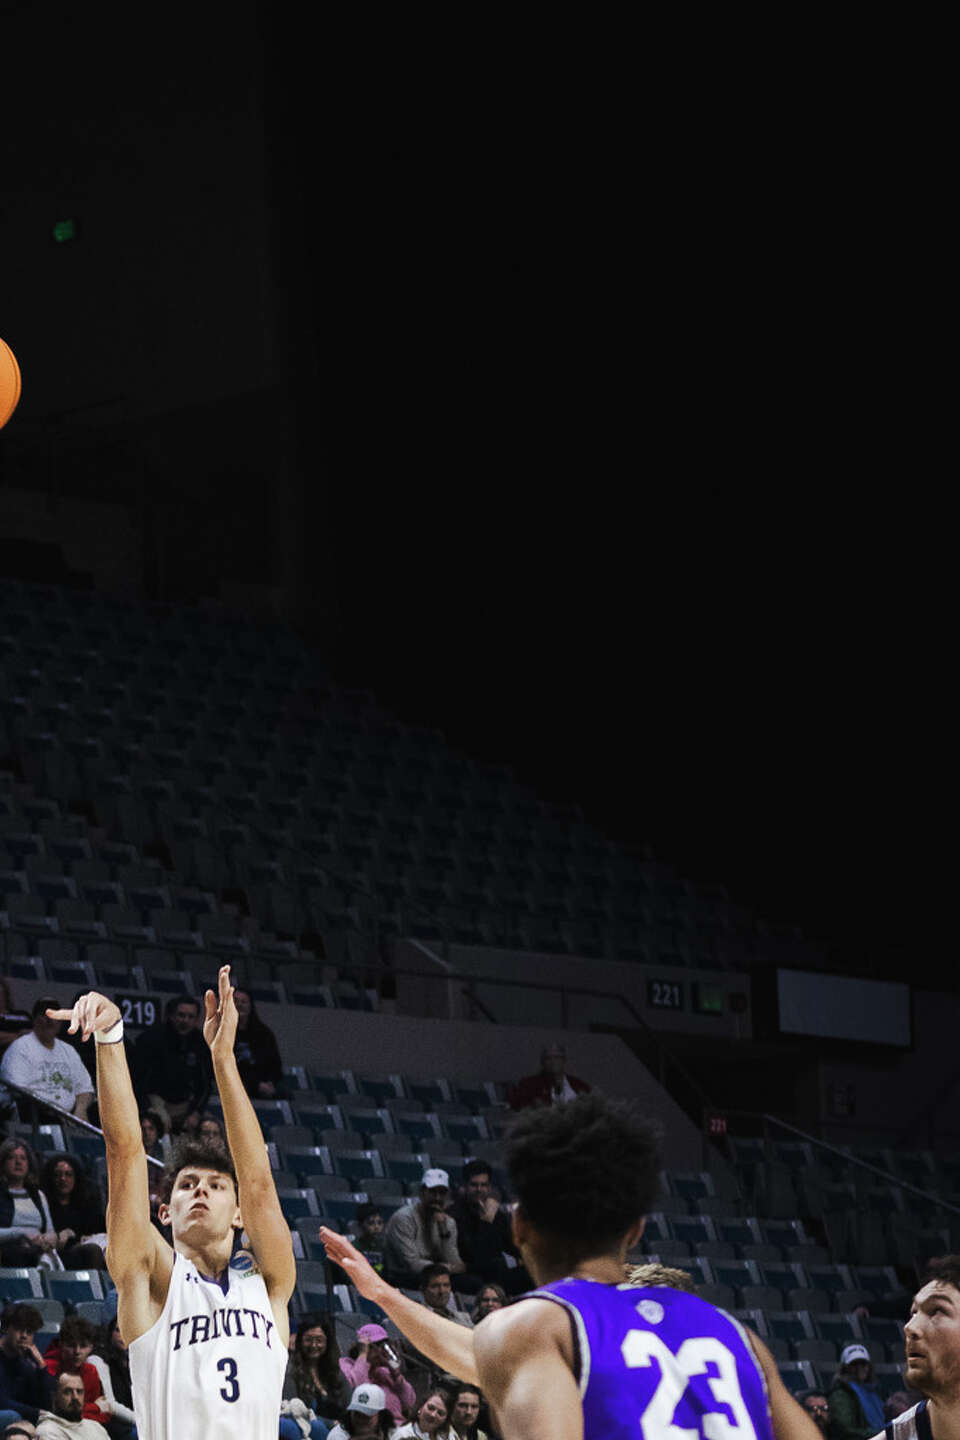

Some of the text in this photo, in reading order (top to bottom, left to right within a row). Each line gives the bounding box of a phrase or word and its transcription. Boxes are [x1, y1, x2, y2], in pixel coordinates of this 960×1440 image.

[651, 983, 680, 1007] 221
[122, 999, 155, 1025] 219
[217, 1357, 241, 1403] 3
